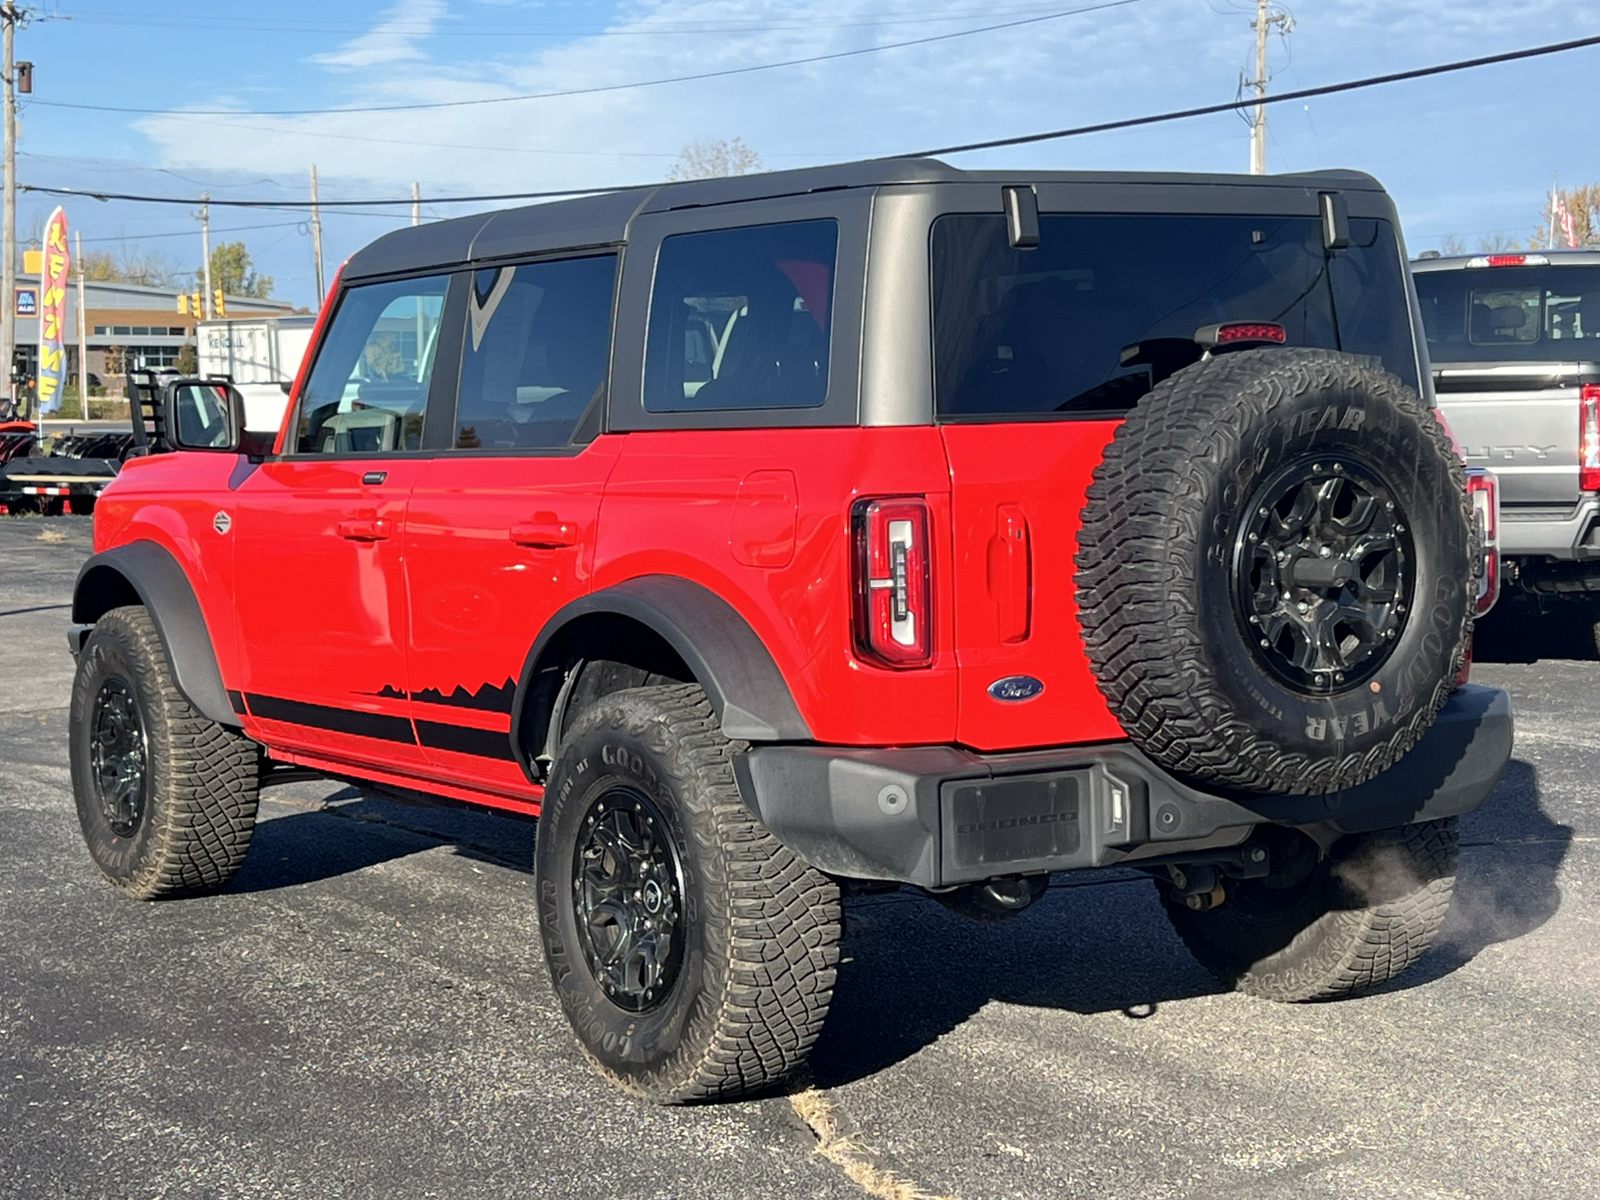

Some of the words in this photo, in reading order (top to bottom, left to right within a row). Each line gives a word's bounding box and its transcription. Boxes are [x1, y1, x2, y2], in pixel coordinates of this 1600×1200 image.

[1461, 445, 1557, 460] UTY
[1001, 682, 1032, 697] Ford
[1304, 700, 1391, 741] YEAR
[956, 811, 1078, 835] BRONCO
[541, 880, 573, 984] YEAR
